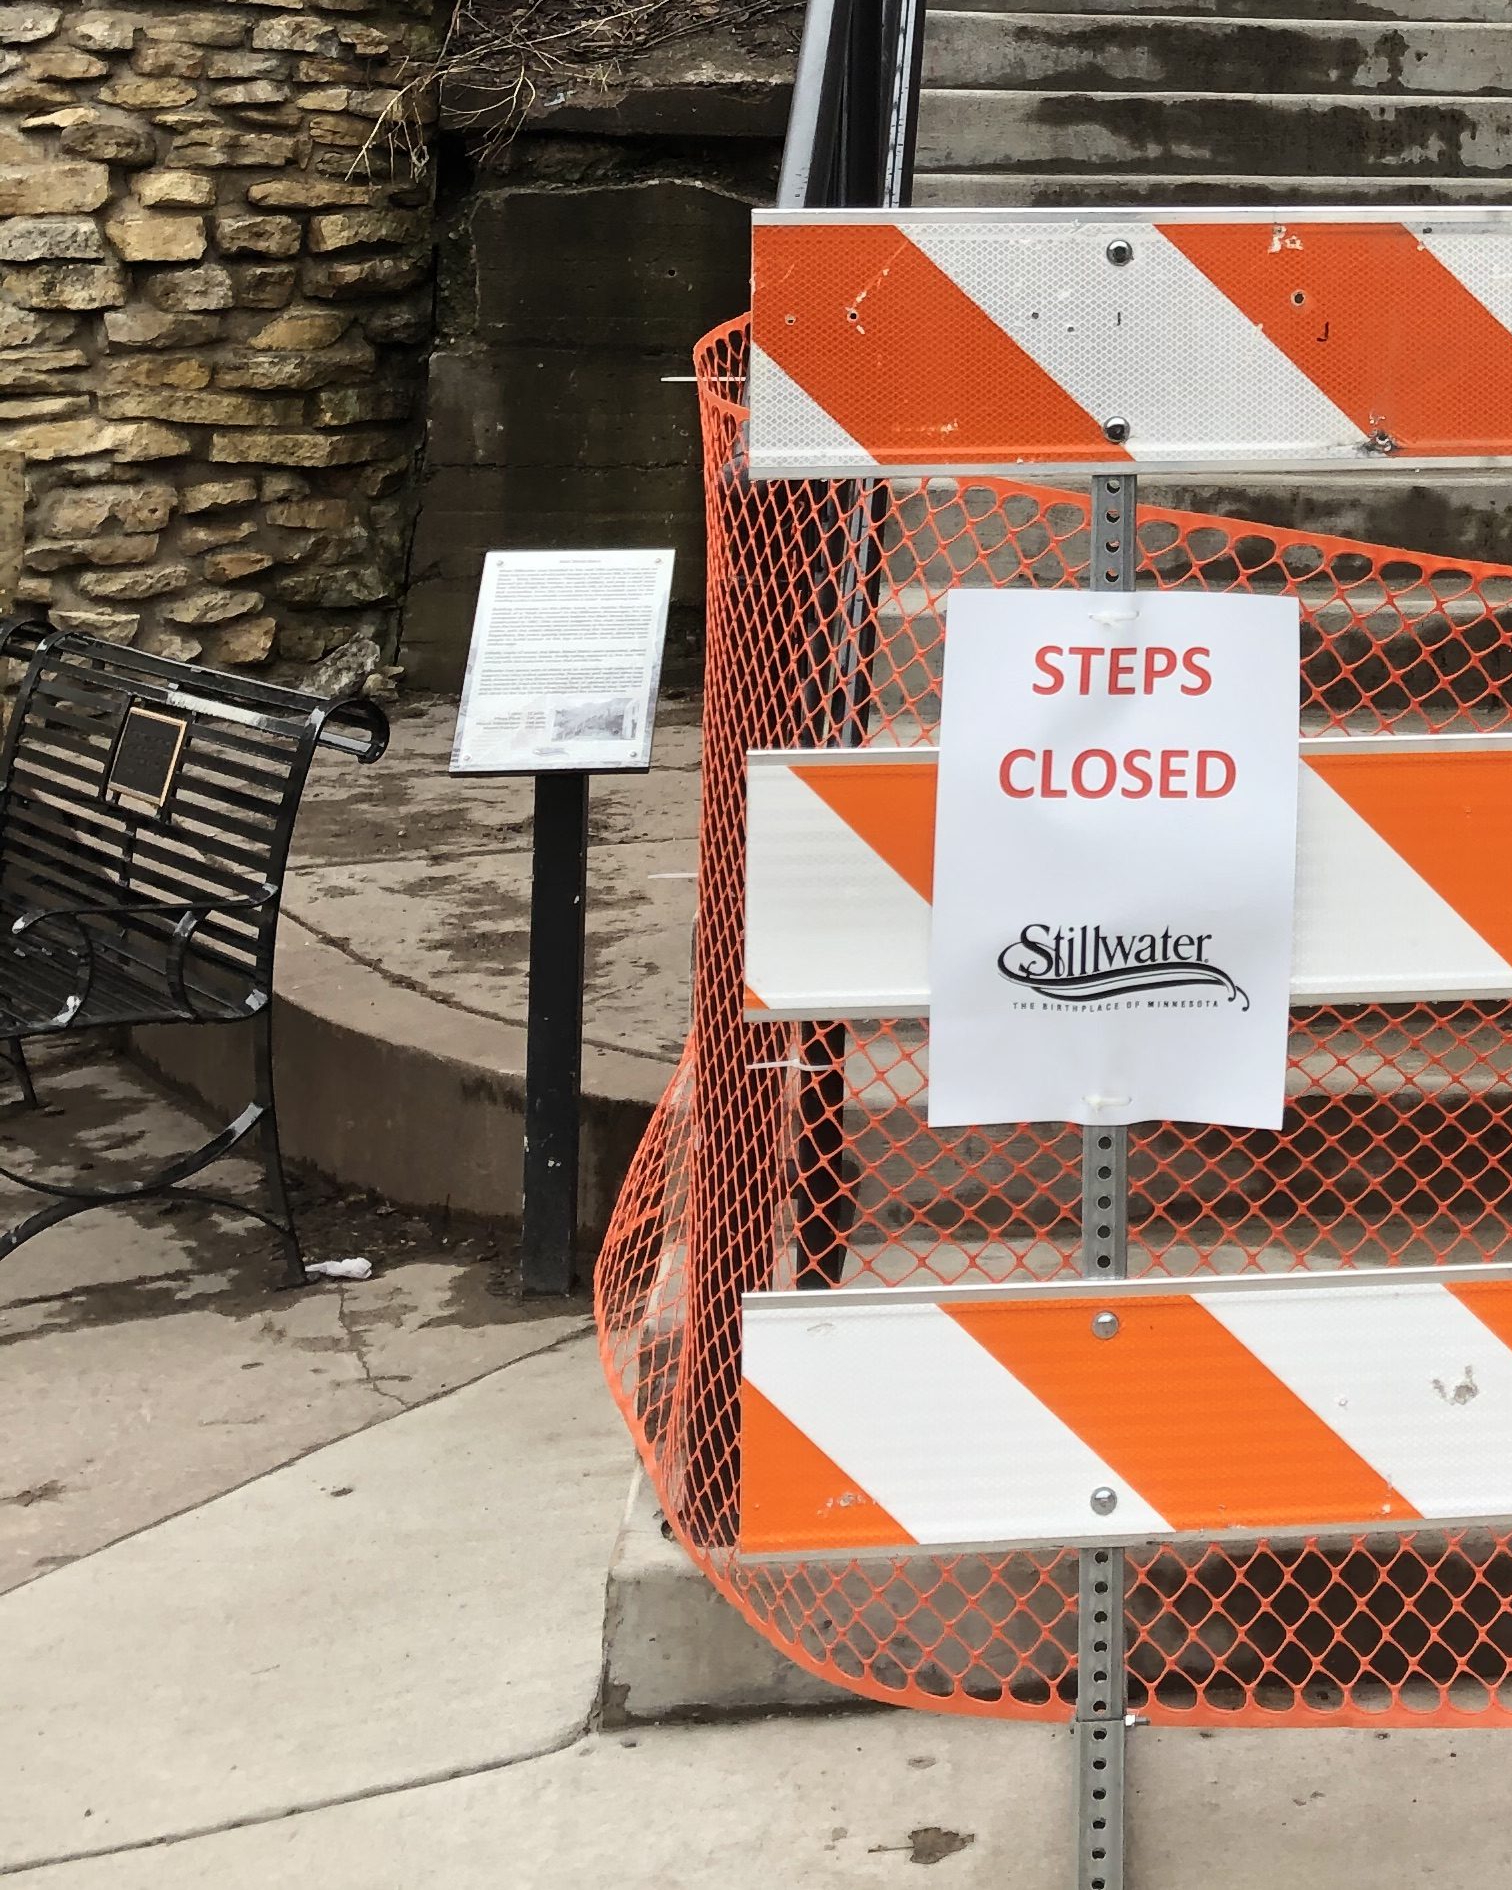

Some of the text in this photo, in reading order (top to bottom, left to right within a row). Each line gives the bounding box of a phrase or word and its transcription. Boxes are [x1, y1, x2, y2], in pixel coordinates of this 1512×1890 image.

[1031, 644, 1213, 697] STEPS
[998, 748, 1237, 800] CLOSED
[998, 922, 1214, 982] Stillwater
[1012, 999, 1220, 1013] THE BIRTHPLACE OF MINNESOTA
